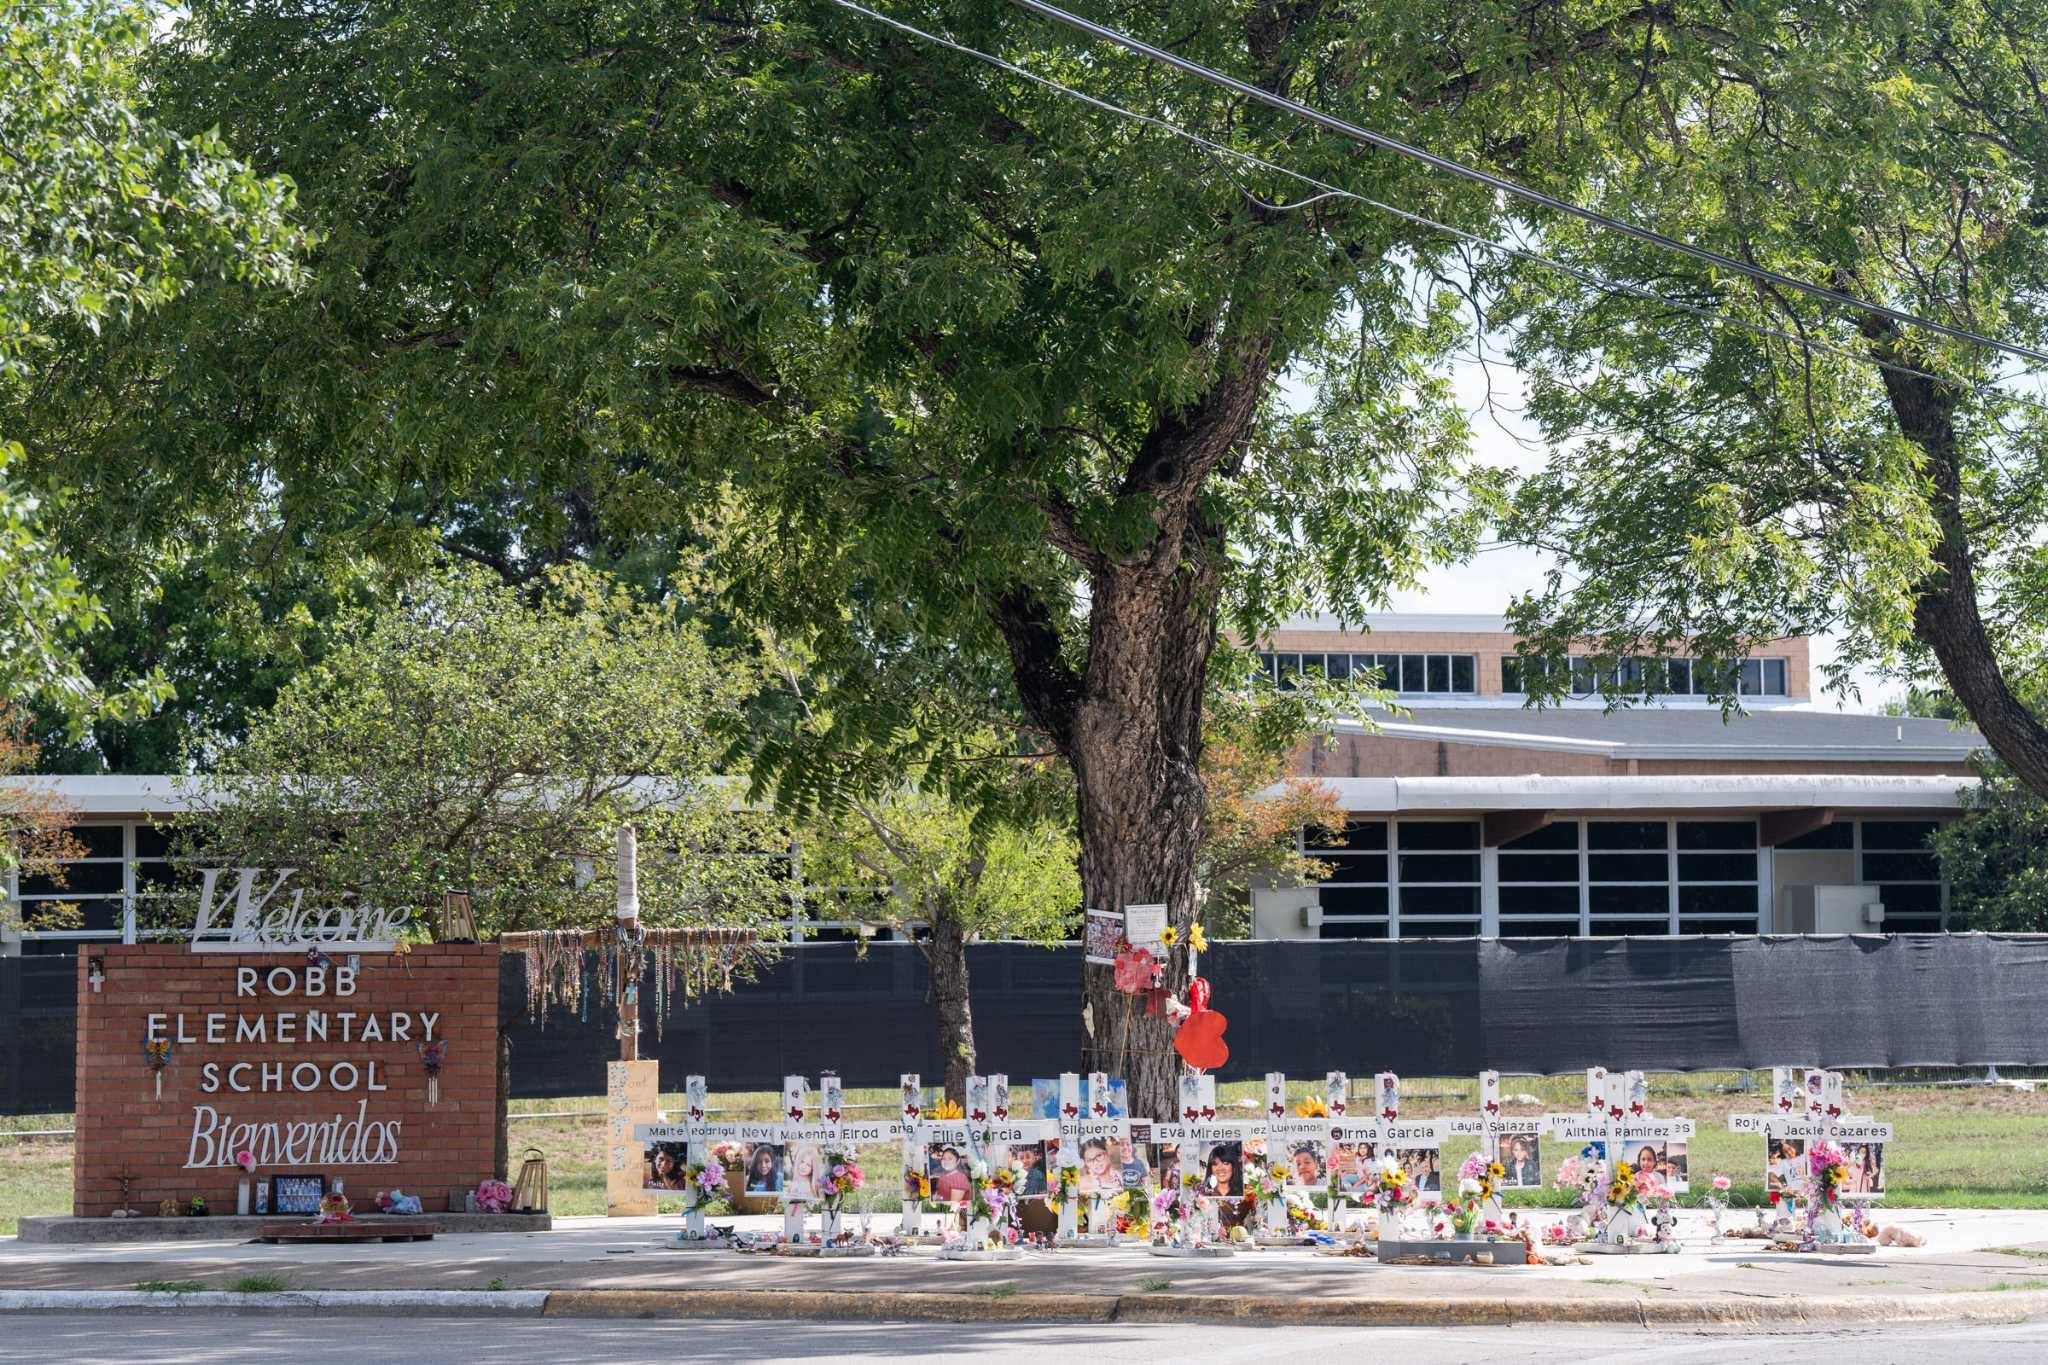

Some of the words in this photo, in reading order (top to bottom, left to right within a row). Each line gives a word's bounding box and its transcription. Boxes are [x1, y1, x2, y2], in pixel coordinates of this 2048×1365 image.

[192, 868, 411, 944] Welcome
[237, 967, 357, 997] ROBB
[147, 1012, 441, 1043] ELEMENTARY
[202, 1061, 387, 1093] SCHOOL
[649, 1127, 684, 1136] Maite
[1062, 1124, 1118, 1137] Silguero
[1159, 1127, 1186, 1139] Eva
[1190, 1127, 1241, 1139] Mireles
[1344, 1128, 1377, 1139] Irma
[1387, 1127, 1434, 1139] Garcia
[1450, 1121, 1483, 1133] Layla
[1489, 1120, 1541, 1132] Salazar
[1565, 1126, 1607, 1138] Alithia
[1615, 1126, 1670, 1138] Ramirez
[1784, 1124, 1824, 1136] Jackie
[1829, 1125, 1888, 1137] Cazares
[184, 1099, 402, 1168] Bienvenidos
[780, 1129, 836, 1140] Makenna
[842, 1127, 879, 1140] Elrod
[932, 1129, 964, 1142] Ellie
[971, 1129, 1023, 1141] Grcia
